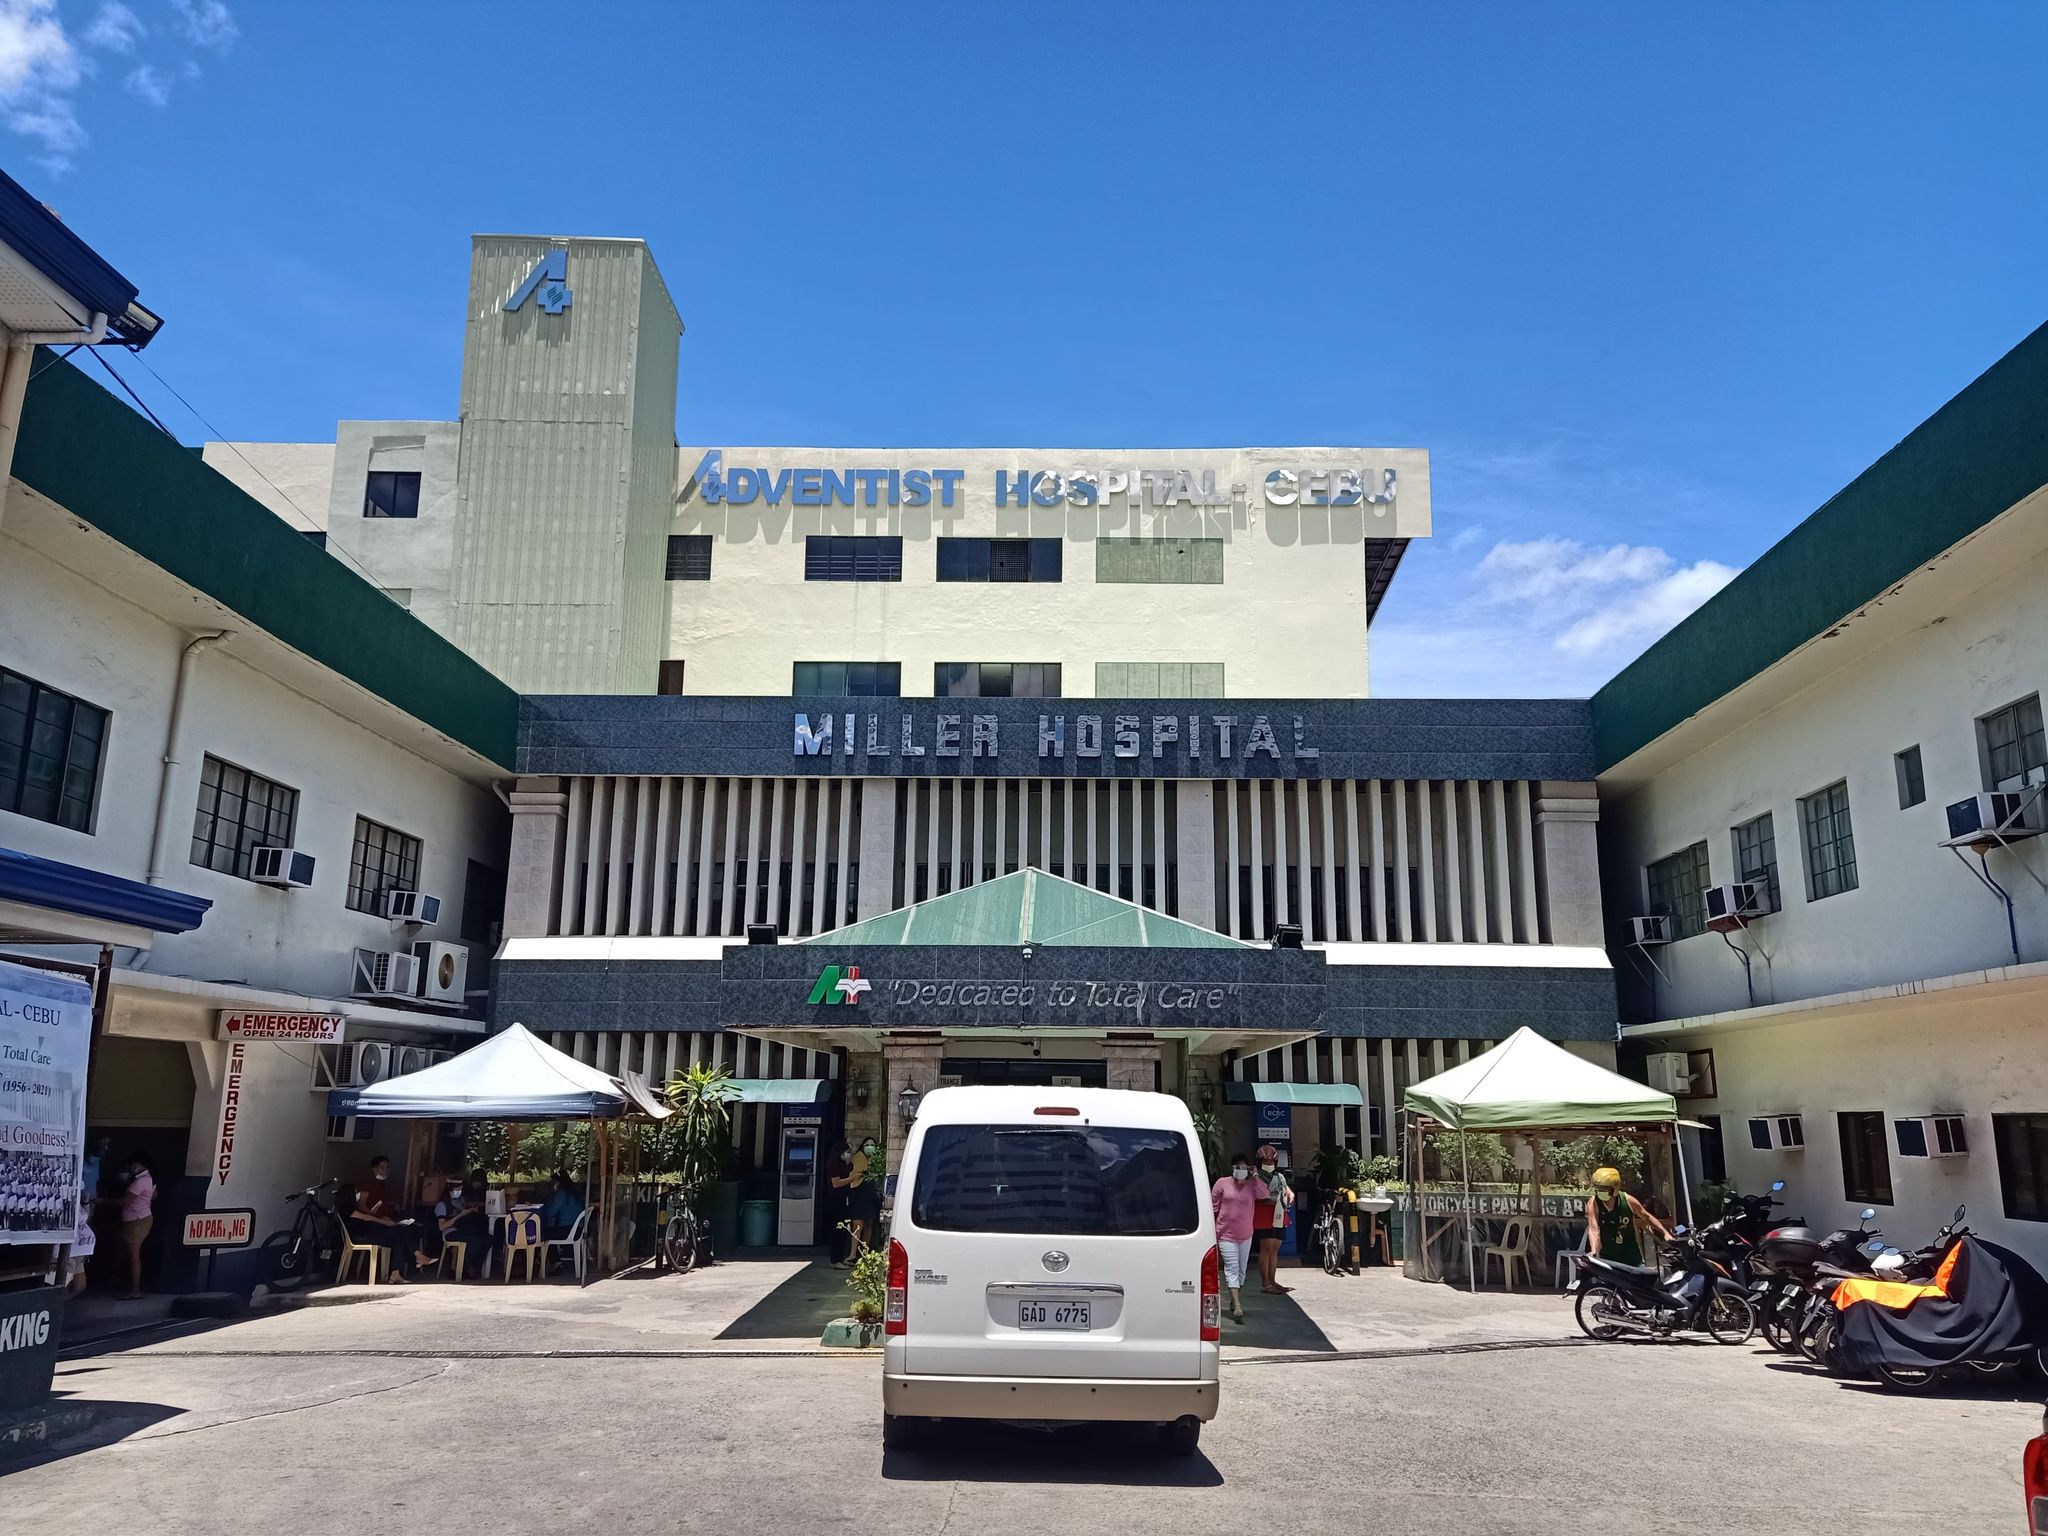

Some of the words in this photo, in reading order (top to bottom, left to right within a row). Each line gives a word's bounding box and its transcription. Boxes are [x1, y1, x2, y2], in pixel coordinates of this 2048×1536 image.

[677, 450, 964, 507] ADVENTIST
[996, 469, 1231, 507] HOSPITAL
[1265, 468, 1397, 506] CEBU
[794, 713, 999, 756] MILLER
[1039, 714, 1319, 759] HOSPITAL
[1047, 981, 1077, 1007] to
[1086, 981, 1151, 1009] Total
[1157, 982, 1242, 1010] Care"
[23, 1004, 61, 1026] CEBU
[242, 1014, 342, 1032] EMERGENCY
[243, 1029, 275, 1037] OPEN
[276, 1030, 292, 1038] 24
[295, 1030, 334, 1040] HOURS
[3, 1045, 29, 1062] Total
[31, 1050, 52, 1065] Care
[3, 1080, 26, 1093] (1956
[218, 1043, 245, 1186] EMERGENCY
[0, 1125, 8, 1143] d
[13, 1125, 70, 1147] Goodness!
[1396, 1195, 1488, 1214] MORCYCLE
[1491, 1197, 1557, 1216] PARKG
[204, 1218, 246, 1241] PARNG
[1021, 1307, 1046, 1323] GAD
[1055, 1308, 1088, 1324] 6775
[0, 1310, 50, 1353] KING
